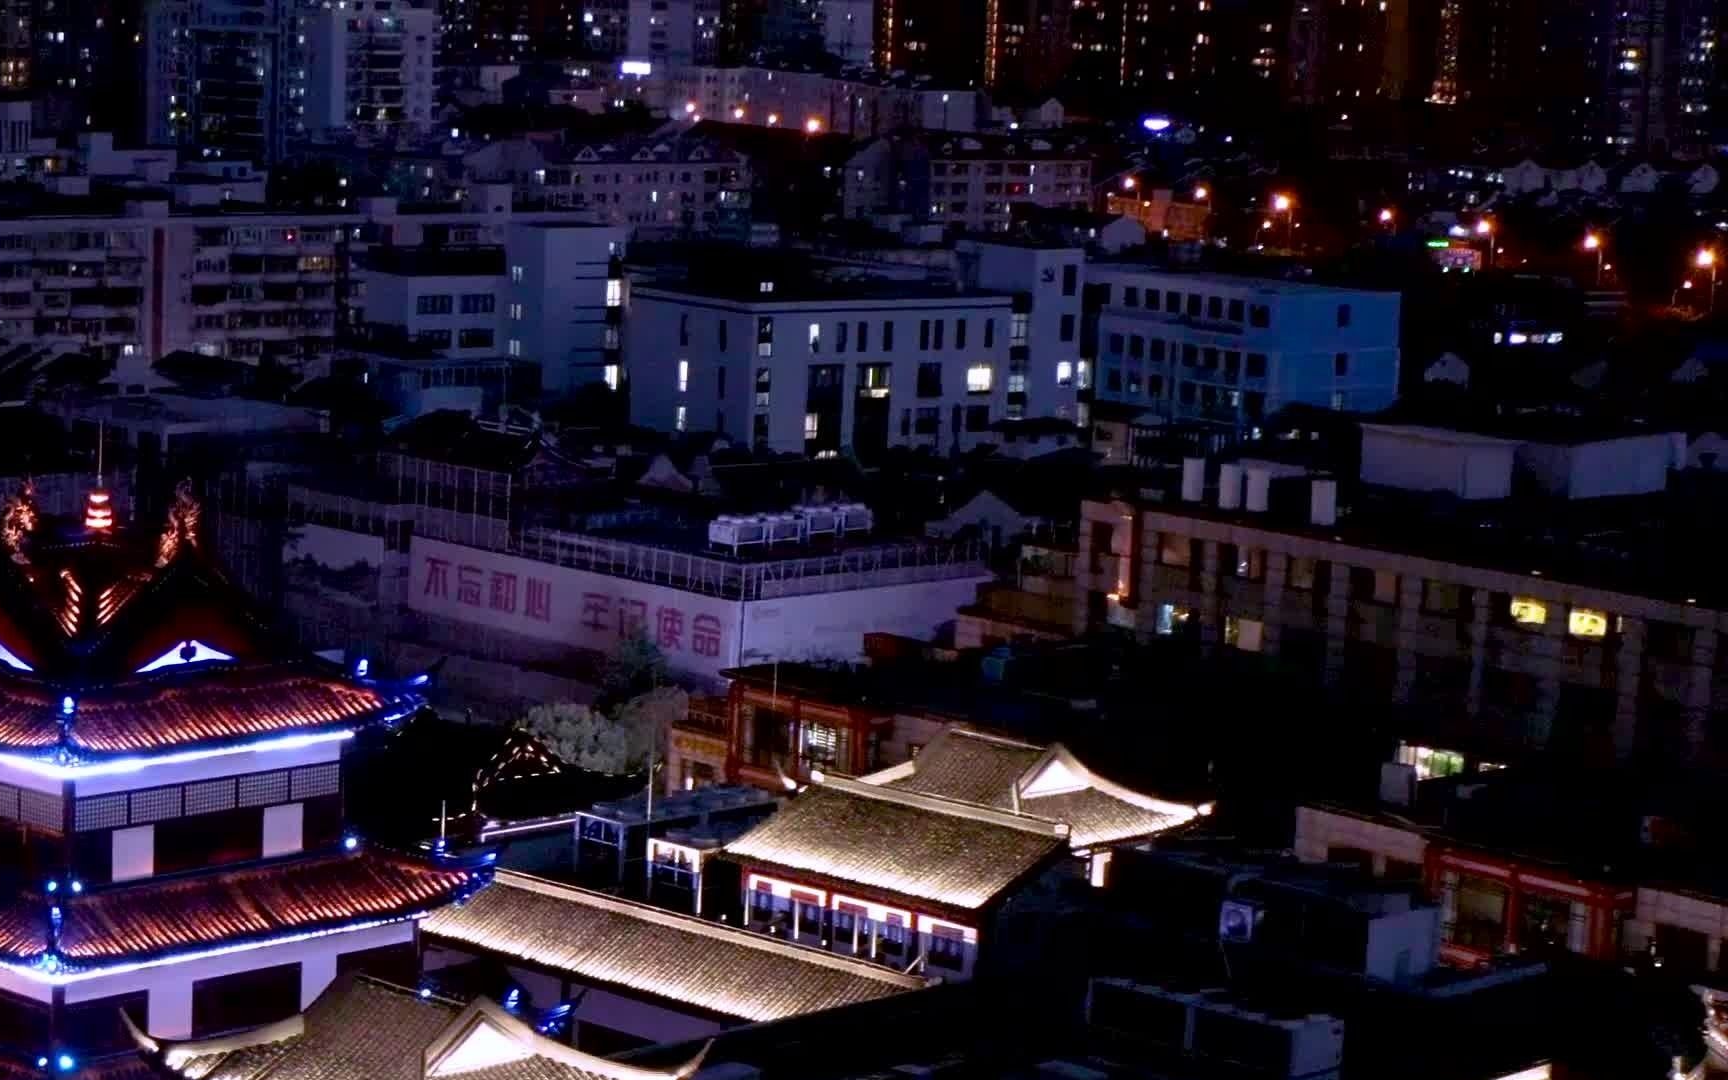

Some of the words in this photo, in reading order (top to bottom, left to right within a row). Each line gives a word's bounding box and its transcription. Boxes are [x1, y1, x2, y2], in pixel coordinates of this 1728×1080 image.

[424, 557, 550, 621] 不忘初心
[583, 592, 721, 656] 牢记使命
